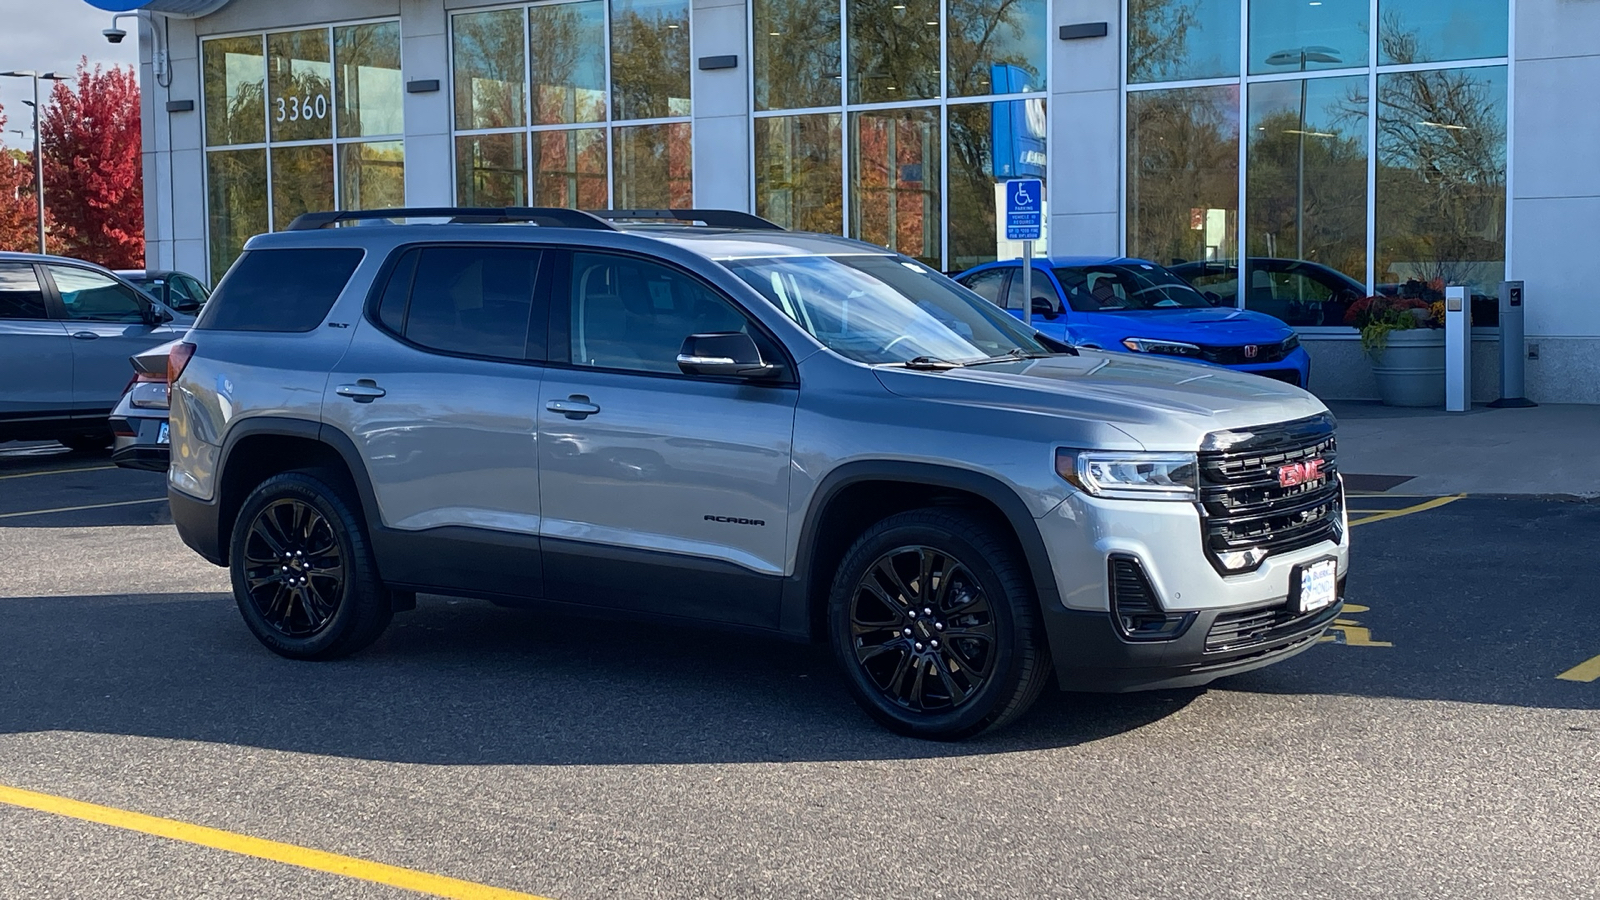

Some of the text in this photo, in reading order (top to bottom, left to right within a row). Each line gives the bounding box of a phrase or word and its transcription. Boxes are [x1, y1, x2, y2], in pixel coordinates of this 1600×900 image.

[276, 94, 327, 122] 3360
[1279, 458, 1326, 488] GMC
[703, 514, 766, 527] ACADIA
[1312, 579, 1333, 596] HONDA
